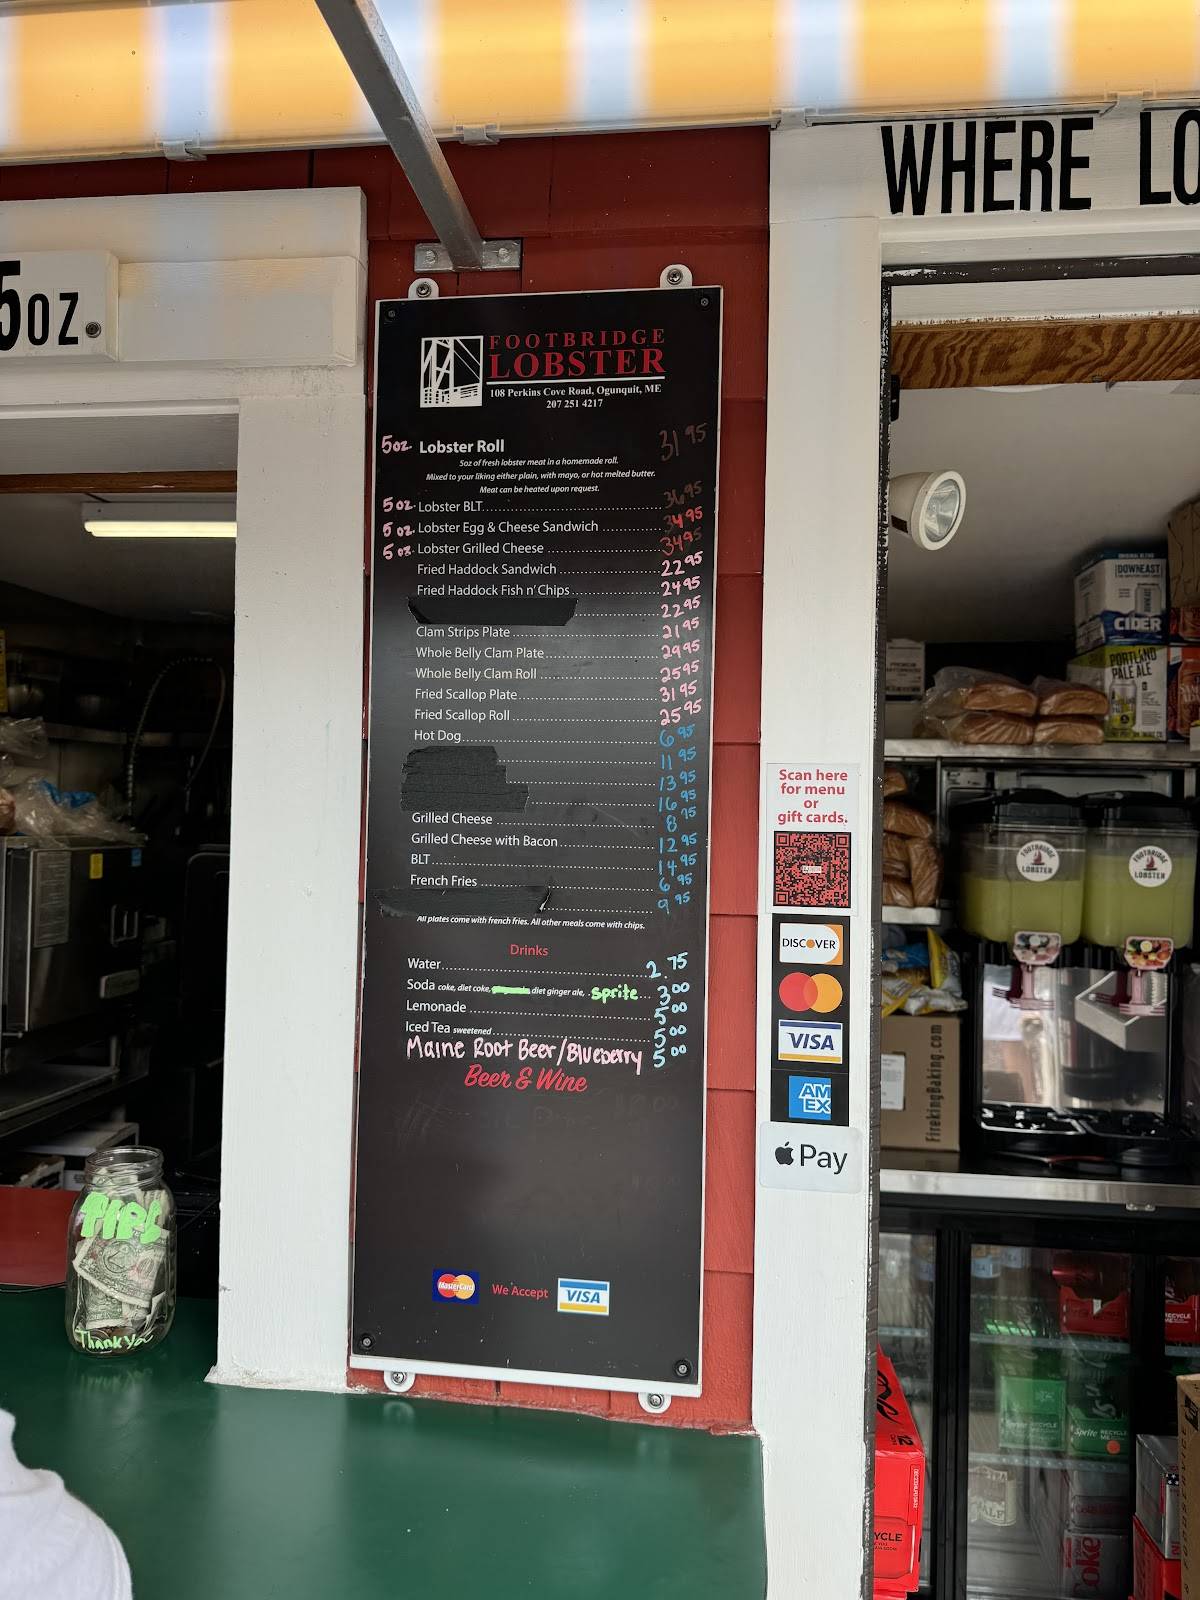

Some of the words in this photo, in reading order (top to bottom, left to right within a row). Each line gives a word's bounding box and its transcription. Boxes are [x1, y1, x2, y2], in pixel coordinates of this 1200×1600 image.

[880, 116, 1094, 216] WHERE
[489, 329, 666, 350] FOOTBRIDGE
[487, 348, 666, 379] LOBSTER
[490, 388, 505, 398] 108
[507, 387, 541, 398] Perkins
[543, 386, 566, 397] Cove
[568, 386, 594, 397] Road,
[596, 384, 643, 397] Ogunquit,
[644, 384, 662, 394] ME
[546, 400, 563, 410] 207
[564, 399, 579, 409] 251
[581, 398, 603, 408] 4217
[419, 440, 474, 454] Lobster
[476, 438, 505, 453] Roll
[459, 458, 472, 467] 5oz
[482, 457, 500, 468] fresh
[501, 457, 526, 467] lobster
[527, 457, 546, 467] meat
[562, 456, 603, 466] homemade
[604, 456, 619, 465] roll.
[426, 472, 449, 481] Mixed
[475, 471, 496, 483] liking
[497, 471, 517, 480] either
[518, 471, 539, 482] plain,
[540, 470, 557, 480] with
[557, 471, 580, 482] mayo,
[604, 469, 630, 479] melted
[631, 469, 656, 478] butter.
[480, 485, 499, 494] Meat
[524, 485, 549, 494] heated
[550, 486, 570, 496] upon
[571, 484, 600, 495] request.
[418, 501, 461, 512] Lobster
[463, 501, 483, 512] BLT
[418, 522, 461, 534] Lobster
[463, 522, 485, 536] Egg
[487, 522, 496, 533] &
[498, 521, 540, 533] Cheese
[542, 520, 599, 532] Sandwich
[418, 543, 460, 555] Lobster
[462, 543, 501, 554] Grilled
[502, 543, 545, 554] Cheese
[417, 563, 446, 575] Fried
[448, 563, 500, 575] Haddock
[501, 563, 557, 575] Sandwich
[1117, 564, 1160, 574] DOWNEAST
[417, 585, 446, 596] Fried
[448, 584, 499, 596] Haddock
[501, 584, 525, 596] Fish
[538, 584, 571, 598] Chips
[1113, 615, 1162, 631] CIDER
[415, 626, 445, 638] Clam
[447, 626, 480, 640] Strips
[482, 626, 511, 638] Plate
[415, 647, 452, 659] Whole
[454, 647, 482, 661] Belly
[484, 647, 514, 659] Clam
[516, 647, 545, 659] Plate
[1109, 647, 1157, 668] PORTLAND
[415, 667, 452, 680] Whole
[454, 667, 482, 682] Belly
[483, 668, 513, 680] Clam
[515, 668, 538, 680] Roll
[1111, 663, 1135, 680] PALE
[1136, 661, 1152, 678] ALE
[415, 688, 444, 700] Fried
[446, 689, 487, 703] Scallop
[489, 689, 518, 701] Plate
[414, 709, 443, 721] Fried
[445, 709, 487, 723] Scallop
[489, 710, 511, 722] Roll
[414, 729, 435, 741] Hot
[437, 729, 462, 744] Dog
[778, 768, 812, 781] Scan
[816, 769, 848, 781] here
[780, 782, 802, 795] for
[804, 784, 846, 795] menu
[803, 799, 819, 809] or
[411, 812, 449, 824] Grilled
[451, 812, 493, 825] Cheese
[777, 810, 806, 825] gift
[806, 811, 849, 823] cards.
[411, 833, 449, 845] Grilled
[450, 833, 493, 845] Cheese
[494, 834, 520, 846] with
[523, 835, 558, 847] Bacon
[410, 853, 431, 865] BLT
[1022, 865, 1053, 874] LOBSTER
[1134, 871, 1166, 880] LOBSTER
[410, 874, 449, 886] French
[451, 875, 478, 887] Fries
[429, 915, 449, 926] plates
[471, 916, 487, 925] with
[488, 916, 511, 926] french
[512, 917, 530, 926] fries.
[542, 918, 562, 927] other
[562, 918, 585, 928] meals
[585, 920, 605, 928] come
[606, 920, 623, 929] with
[623, 920, 646, 931] chips.
[510, 944, 549, 957] Drinks
[782, 937, 836, 950] DISCOVER
[407, 957, 441, 970] Water
[406, 979, 436, 991] Soda
[437, 982, 457, 993] coke,
[472, 983, 492, 995] coke,
[546, 986, 571, 998] ginger
[571, 987, 585, 998] ale,
[591, 984, 639, 1004] sprite
[406, 999, 467, 1013] Lemonade
[405, 1020, 430, 1033] Iced
[430, 1021, 451, 1034] Tea
[452, 1026, 493, 1036] sweetened
[473, 1037, 514, 1059] Root
[787, 1032, 835, 1051] VISA
[464, 1063, 513, 1089] Beer
[515, 1068, 534, 1090] &
[535, 1067, 588, 1093] Wine
[800, 1083, 831, 1099] AM
[804, 1098, 831, 1113] EX
[800, 1143, 848, 1175] Pay
[491, 1283, 509, 1296] We
[511, 1285, 549, 1300] Accept
[566, 1289, 601, 1304] VISA
[1074, 1427, 1098, 1439] Sprite
